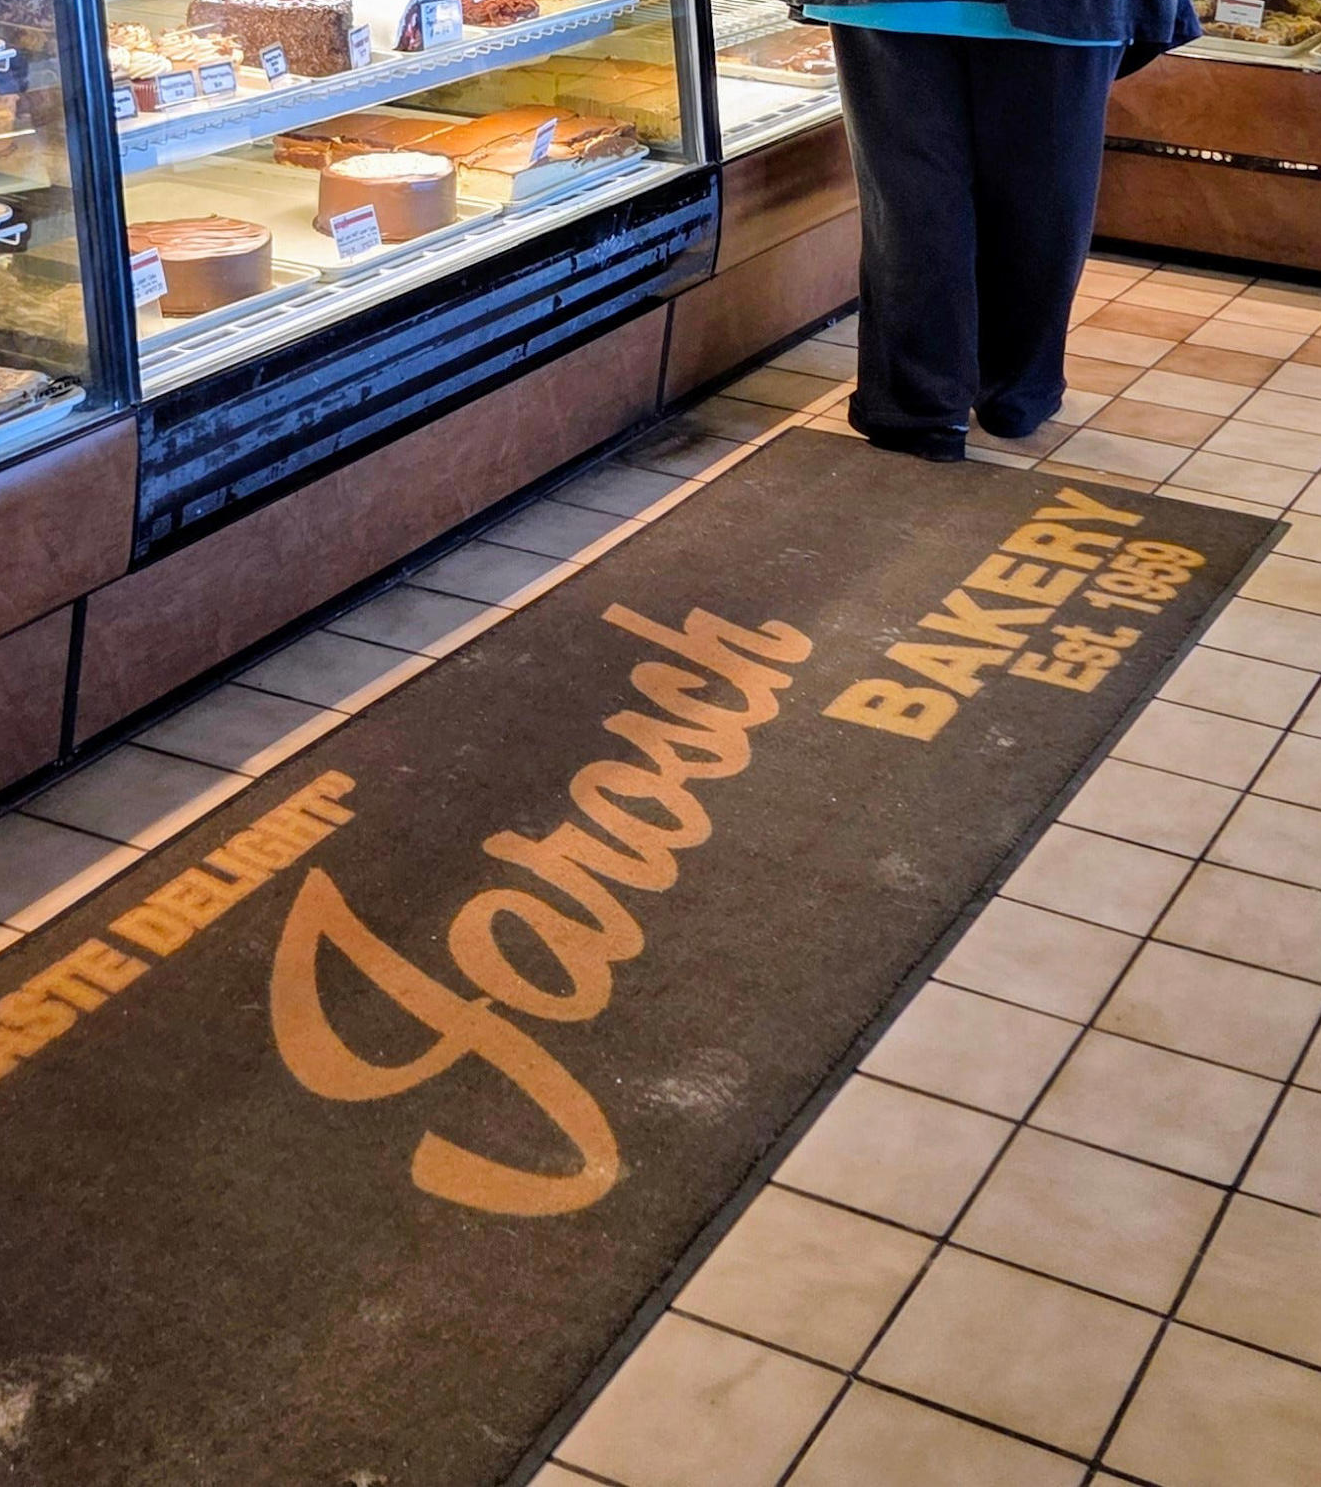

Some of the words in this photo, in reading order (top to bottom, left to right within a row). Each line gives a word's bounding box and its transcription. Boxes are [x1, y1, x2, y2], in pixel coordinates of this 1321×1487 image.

[822, 487, 1145, 742] BAKERY
[1081, 540, 1208, 615] 1959
[270, 602, 814, 1217] Jarosch
